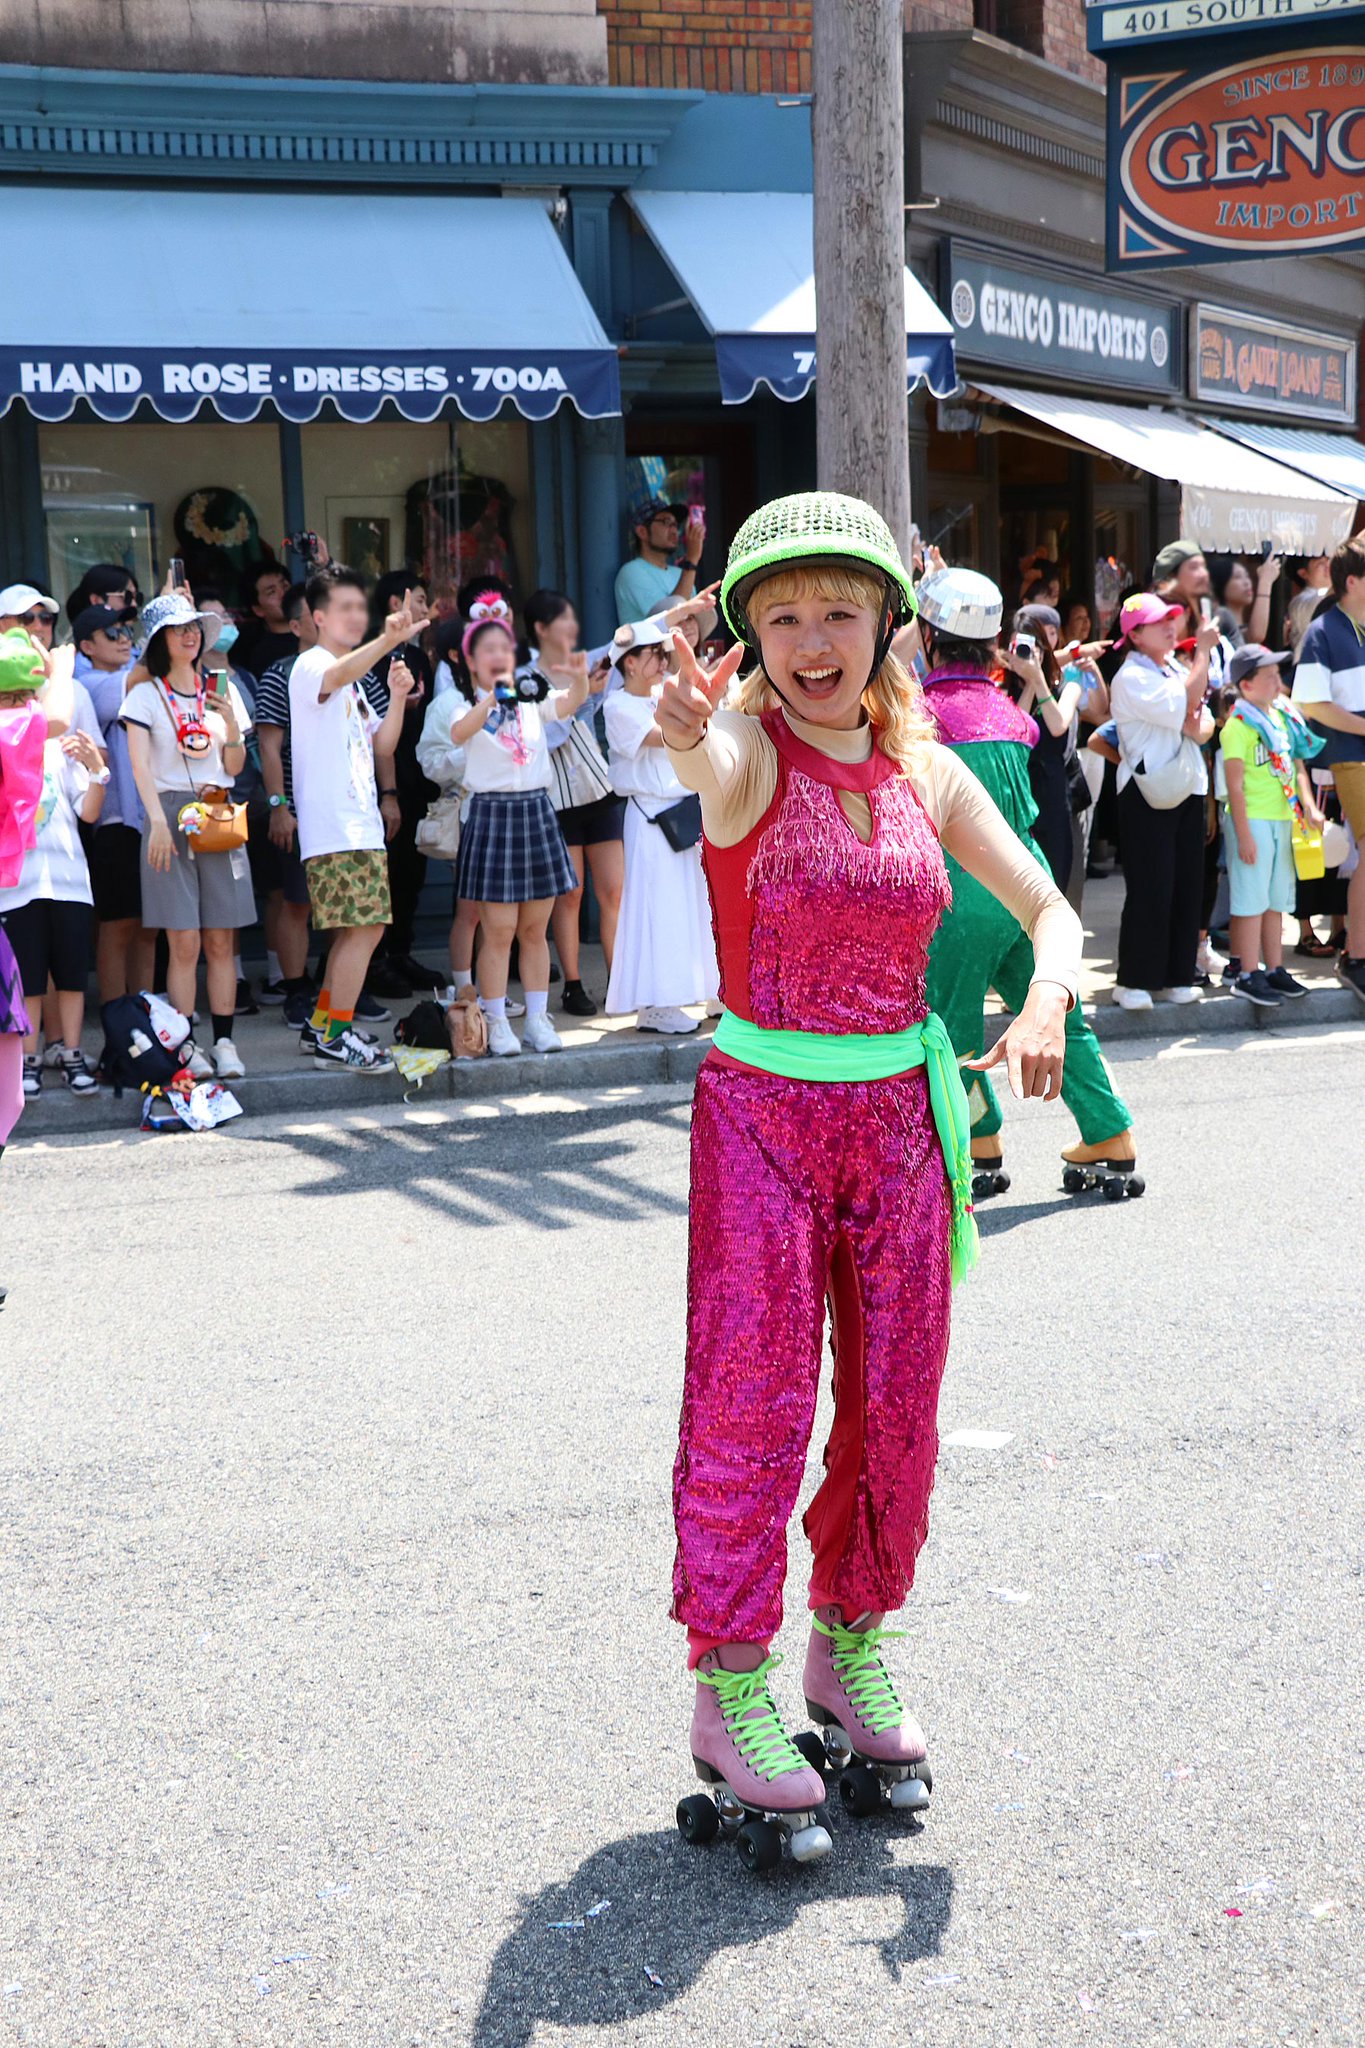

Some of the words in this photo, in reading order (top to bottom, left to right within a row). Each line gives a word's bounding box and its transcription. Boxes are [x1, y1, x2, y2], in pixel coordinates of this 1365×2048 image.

[1124, 9, 1170, 33] 401
[1186, 0, 1294, 27] SOUTH
[1223, 65, 1310, 107] SINCE
[979, 282, 1054, 348] GENCO
[1058, 301, 1148, 363] IMPORTS
[20, 363, 142, 393] HAND
[162, 363, 272, 394] ROSE
[293, 366, 449, 392] DRESSES
[471, 367, 568, 391] 700A
[1229, 508, 1269, 532] GENCO
